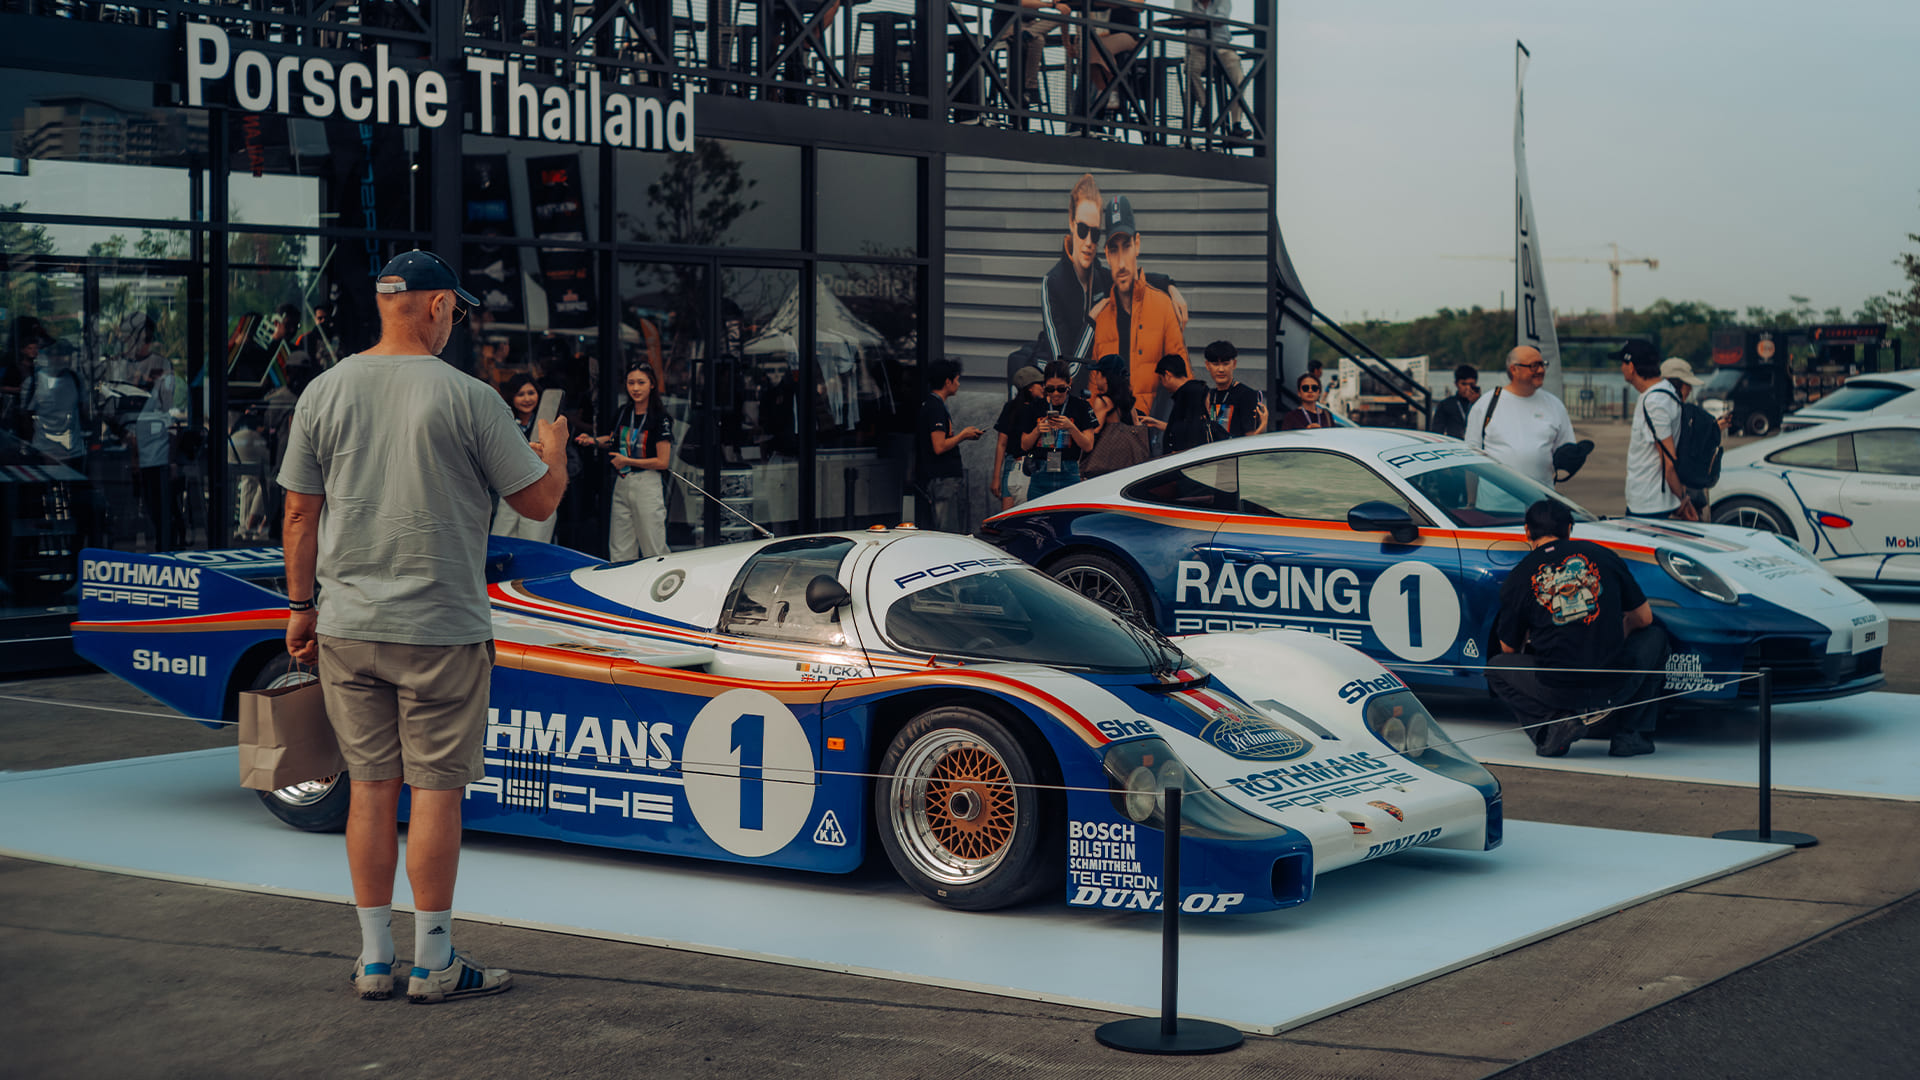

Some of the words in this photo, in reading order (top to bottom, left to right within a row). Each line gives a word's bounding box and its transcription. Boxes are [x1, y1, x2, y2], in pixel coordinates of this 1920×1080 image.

[186, 22, 448, 128] Porsche
[467, 55, 695, 153] Thailand
[82, 560, 201, 590] ROTHMANS
[1175, 560, 1361, 614] RACING
[82, 588, 200, 610] PORSCHE
[1399, 574, 1423, 648] 1
[133, 649, 207, 677] Shell
[828, 666, 863, 678] ICKX
[1338, 672, 1402, 704] Shell
[486, 708, 674, 769] HMANS
[730, 714, 765, 831] 1
[1227, 752, 1389, 798] ROTHMANS
[465, 777, 674, 822] RSCHE
[1268, 773, 1419, 811] PORSCHE
[1069, 820, 1135, 842] BOSCH
[1361, 827, 1442, 860] DUNLOP
[1069, 839, 1136, 860] BILSTEIN
[1069, 857, 1141, 873] SCHMITTHELM
[1069, 870, 1158, 889] TELETRON
[1070, 886, 1245, 913] DUNOP
